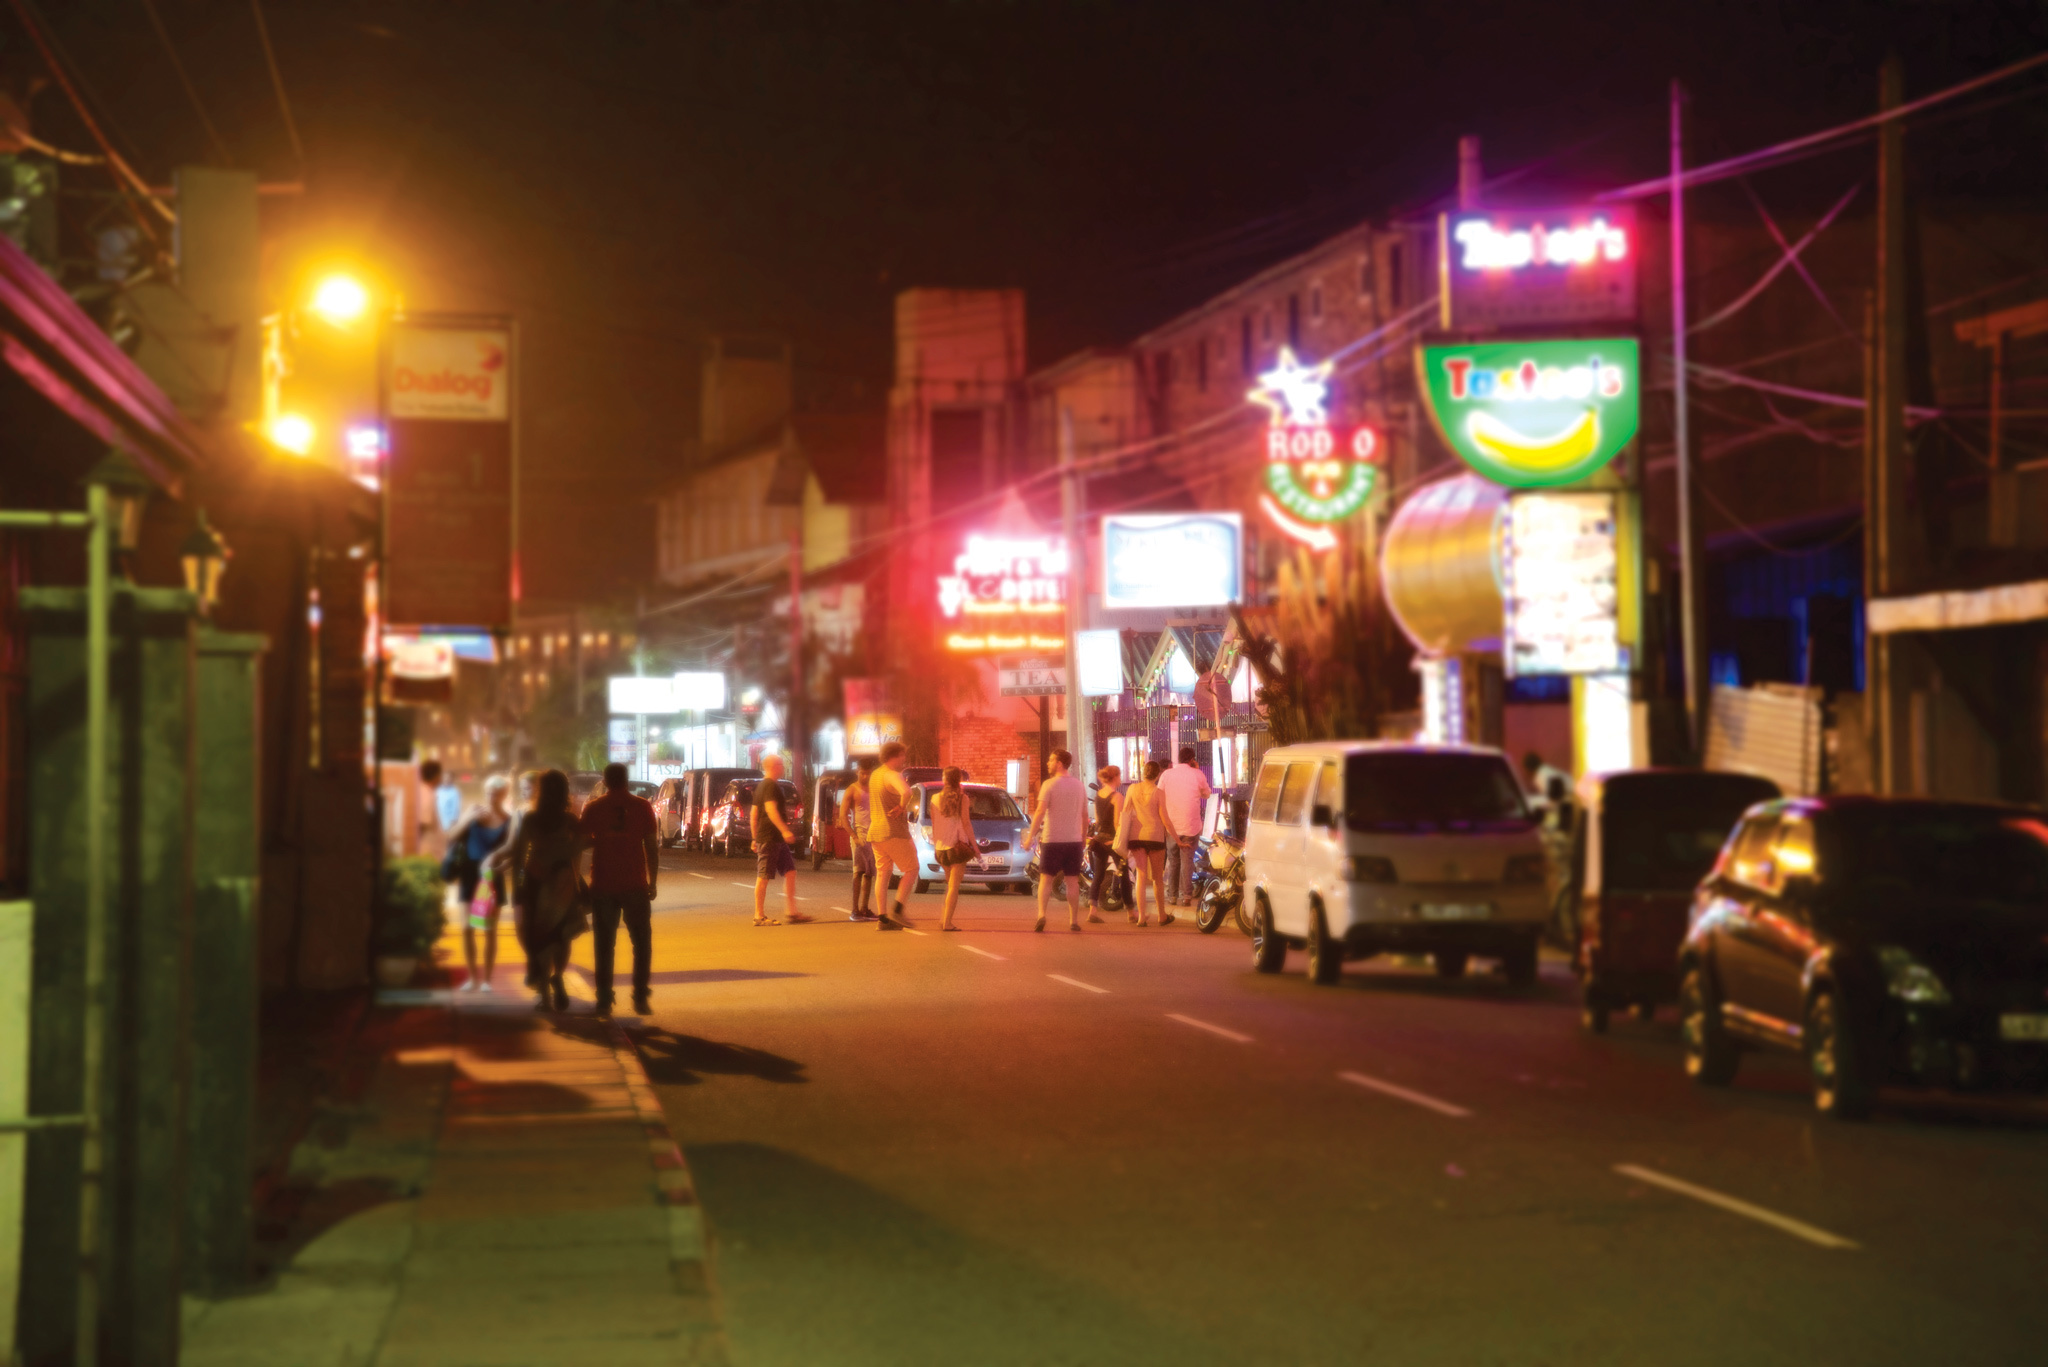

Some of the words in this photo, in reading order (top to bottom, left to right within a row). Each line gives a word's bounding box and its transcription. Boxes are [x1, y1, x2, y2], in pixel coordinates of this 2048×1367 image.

[395, 367, 492, 402] Dialog
[1010, 670, 1060, 686] TEA
[854, 721, 882, 732] Fish
[886, 723, 896, 731] &
[988, 856, 1003, 864] 0941
